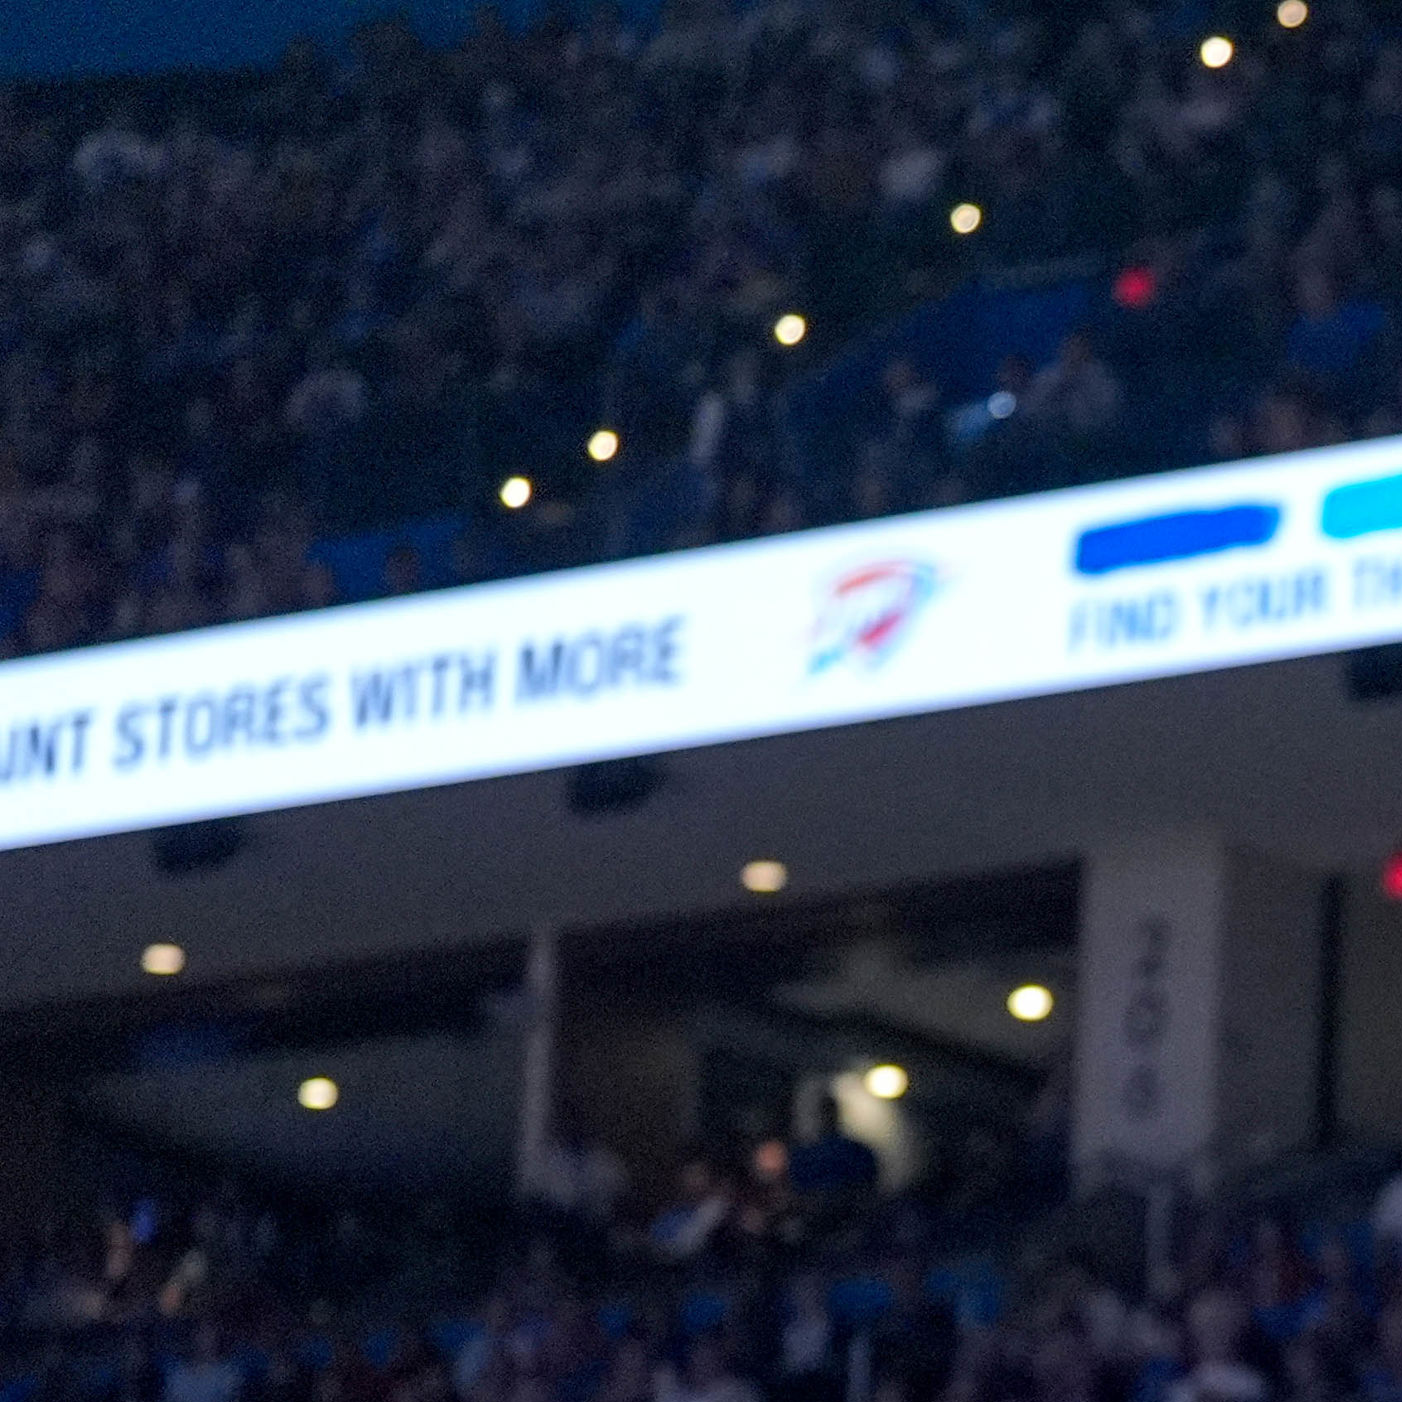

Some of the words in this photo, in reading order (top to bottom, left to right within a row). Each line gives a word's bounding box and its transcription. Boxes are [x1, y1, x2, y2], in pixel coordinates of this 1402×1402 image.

[1068, 592, 1178, 652] FIND
[1201, 567, 1326, 627] YOUR
[112, 672, 332, 773] STORES
[352, 648, 499, 731] WITH
[515, 611, 684, 707] MORE
